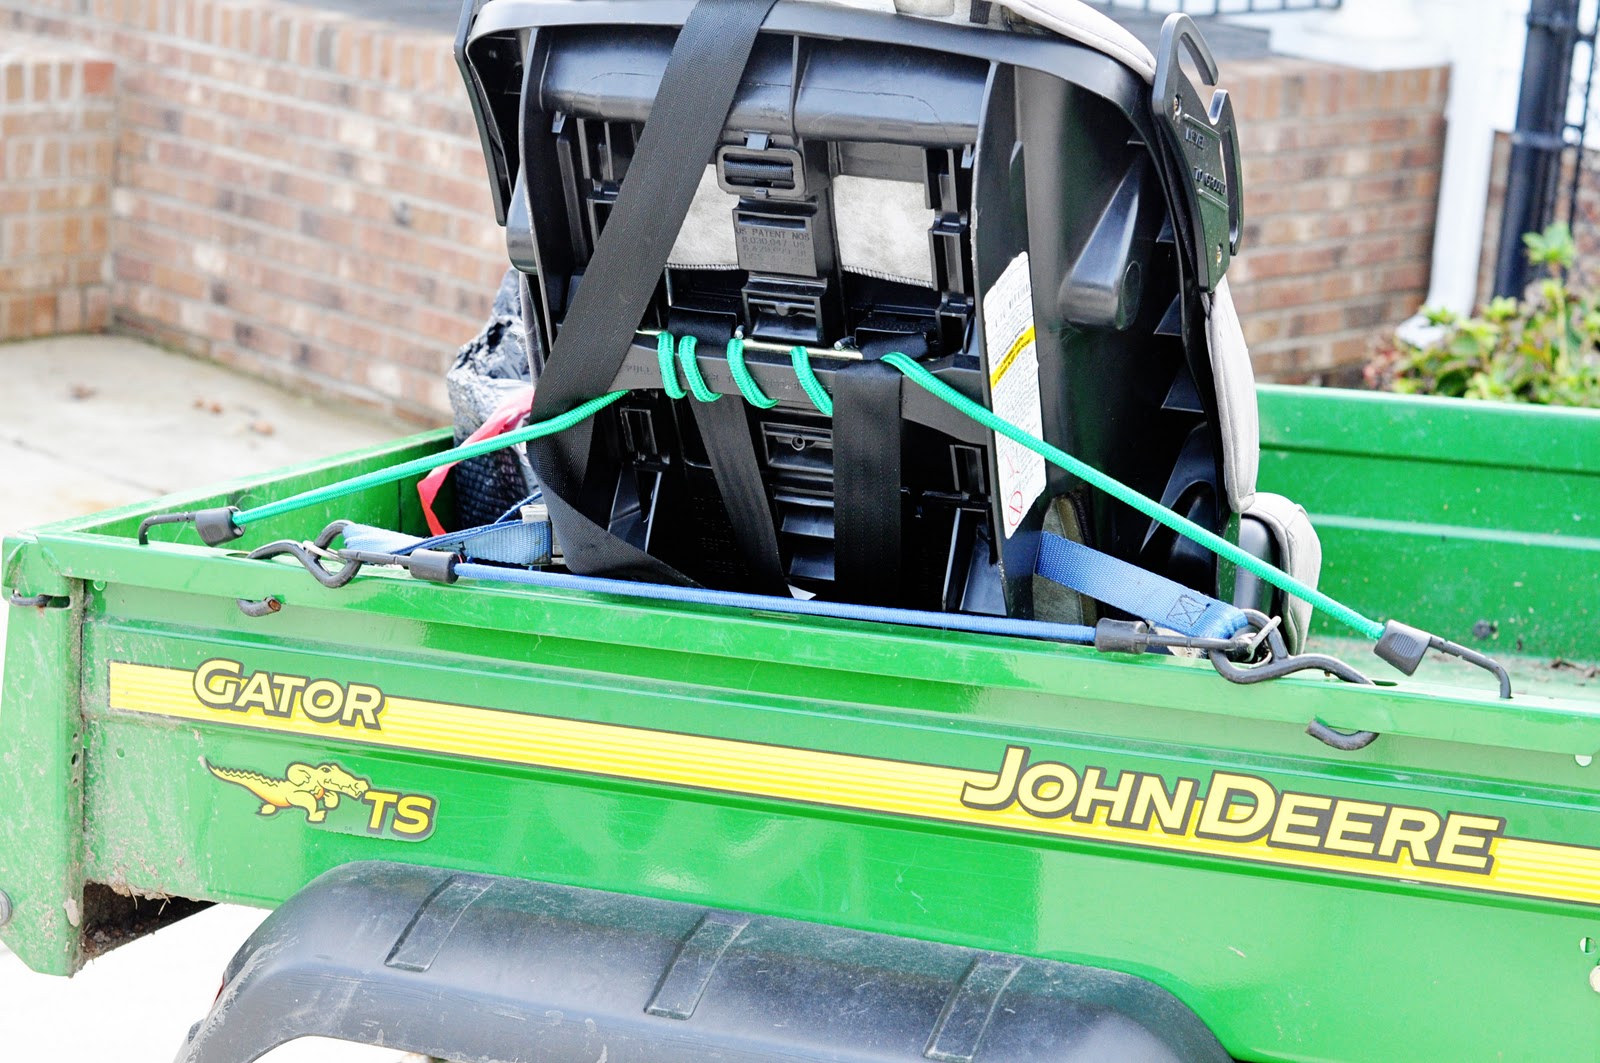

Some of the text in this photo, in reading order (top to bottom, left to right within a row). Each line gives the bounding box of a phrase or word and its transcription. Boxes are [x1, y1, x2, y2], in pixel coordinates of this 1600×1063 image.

[1194, 165, 1203, 182] TO
[752, 228, 786, 239] PATENT
[193, 657, 382, 730] GATOR
[361, 789, 437, 839] TS
[960, 744, 1507, 876] JOHN DEERE
